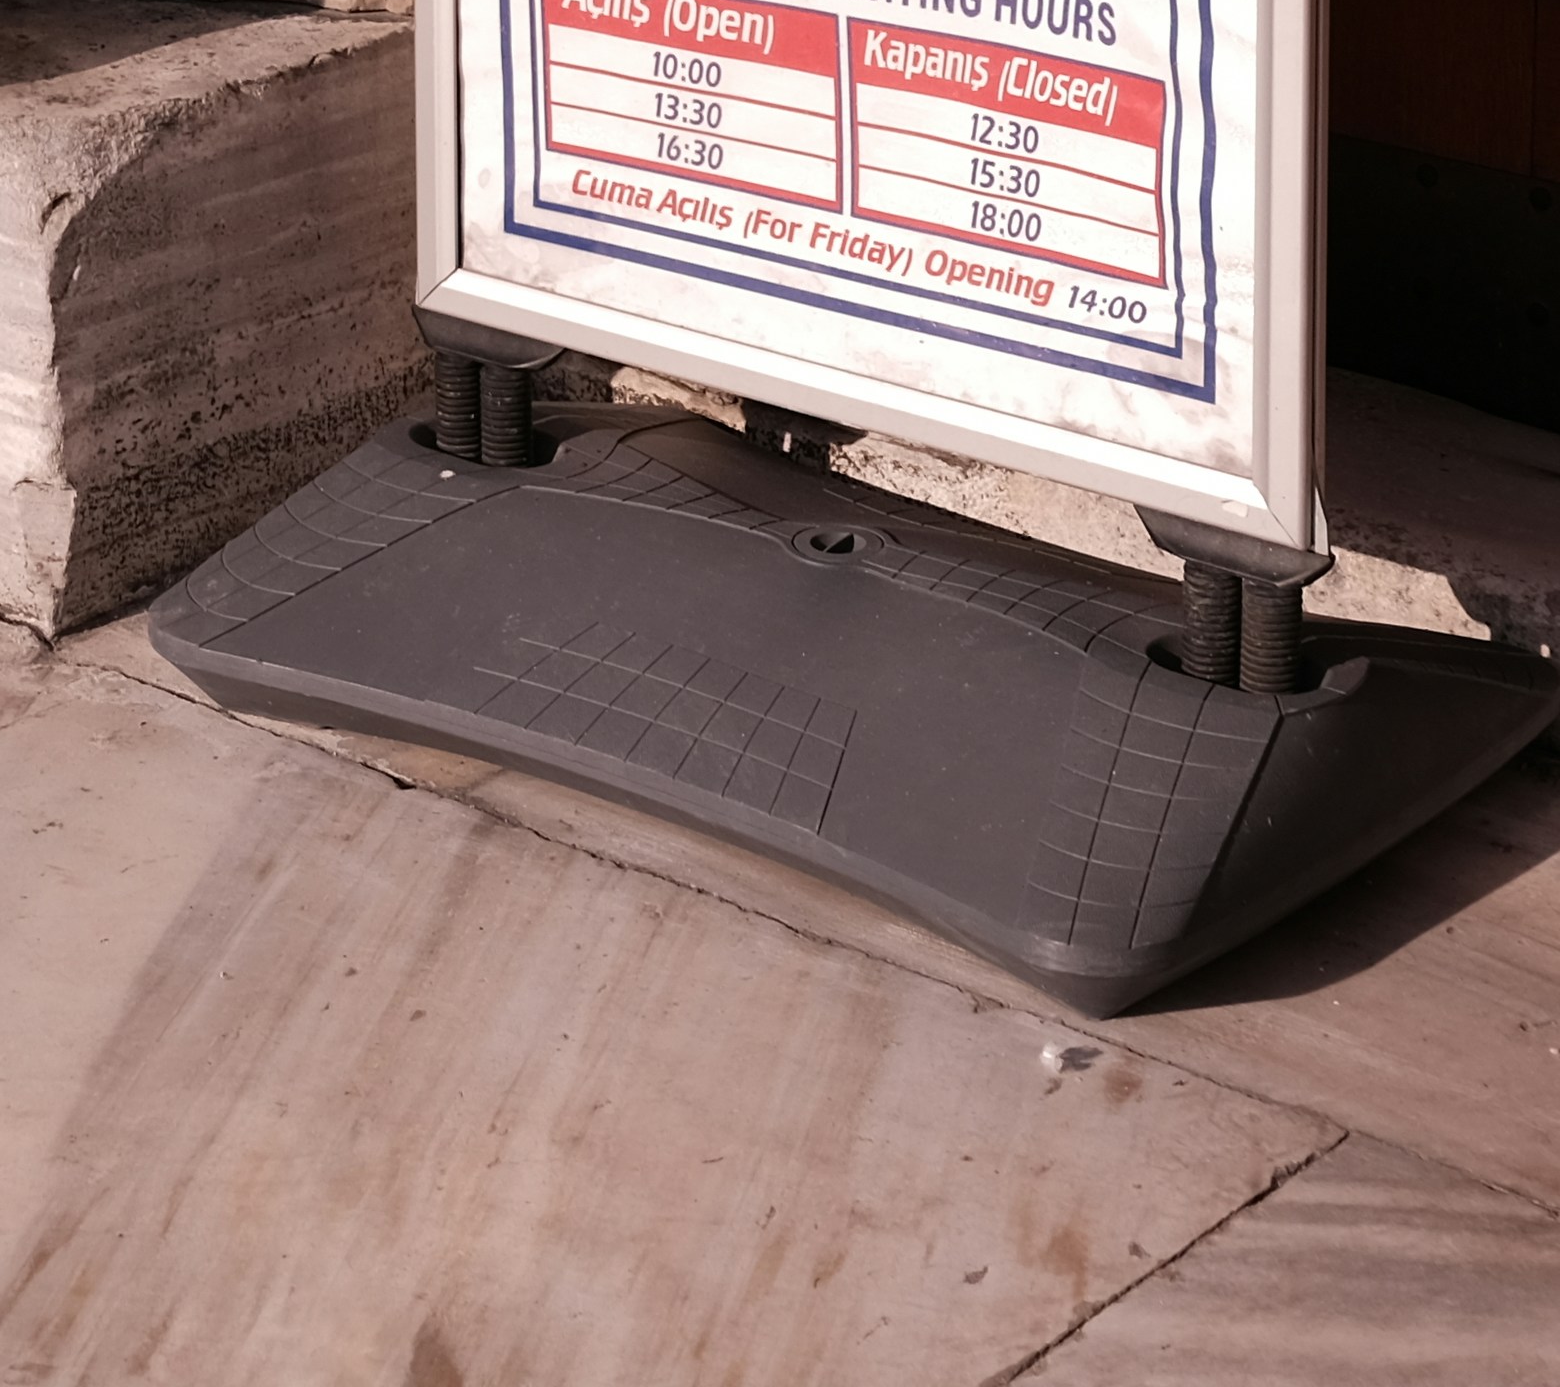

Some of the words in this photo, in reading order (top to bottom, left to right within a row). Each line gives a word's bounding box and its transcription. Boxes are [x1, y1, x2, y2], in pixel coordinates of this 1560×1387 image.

[653, 51, 722, 87] 10:00
[864, 29, 989, 91] Kapanış
[998, 57, 1118, 126] (Closed)
[655, 92, 722, 128] 13:30
[657, 132, 723, 170] 16:30
[970, 113, 1039, 153] 12:30
[970, 157, 1040, 197] 15:30
[970, 201, 1042, 241] 18:00
[572, 169, 653, 210] Cuma
[657, 188, 734, 230] Açılış
[743, 209, 802, 242] (For
[809, 222, 912, 277] Friday)
[925, 249, 1054, 307] Opening
[1068, 285, 1147, 324] 14:00
